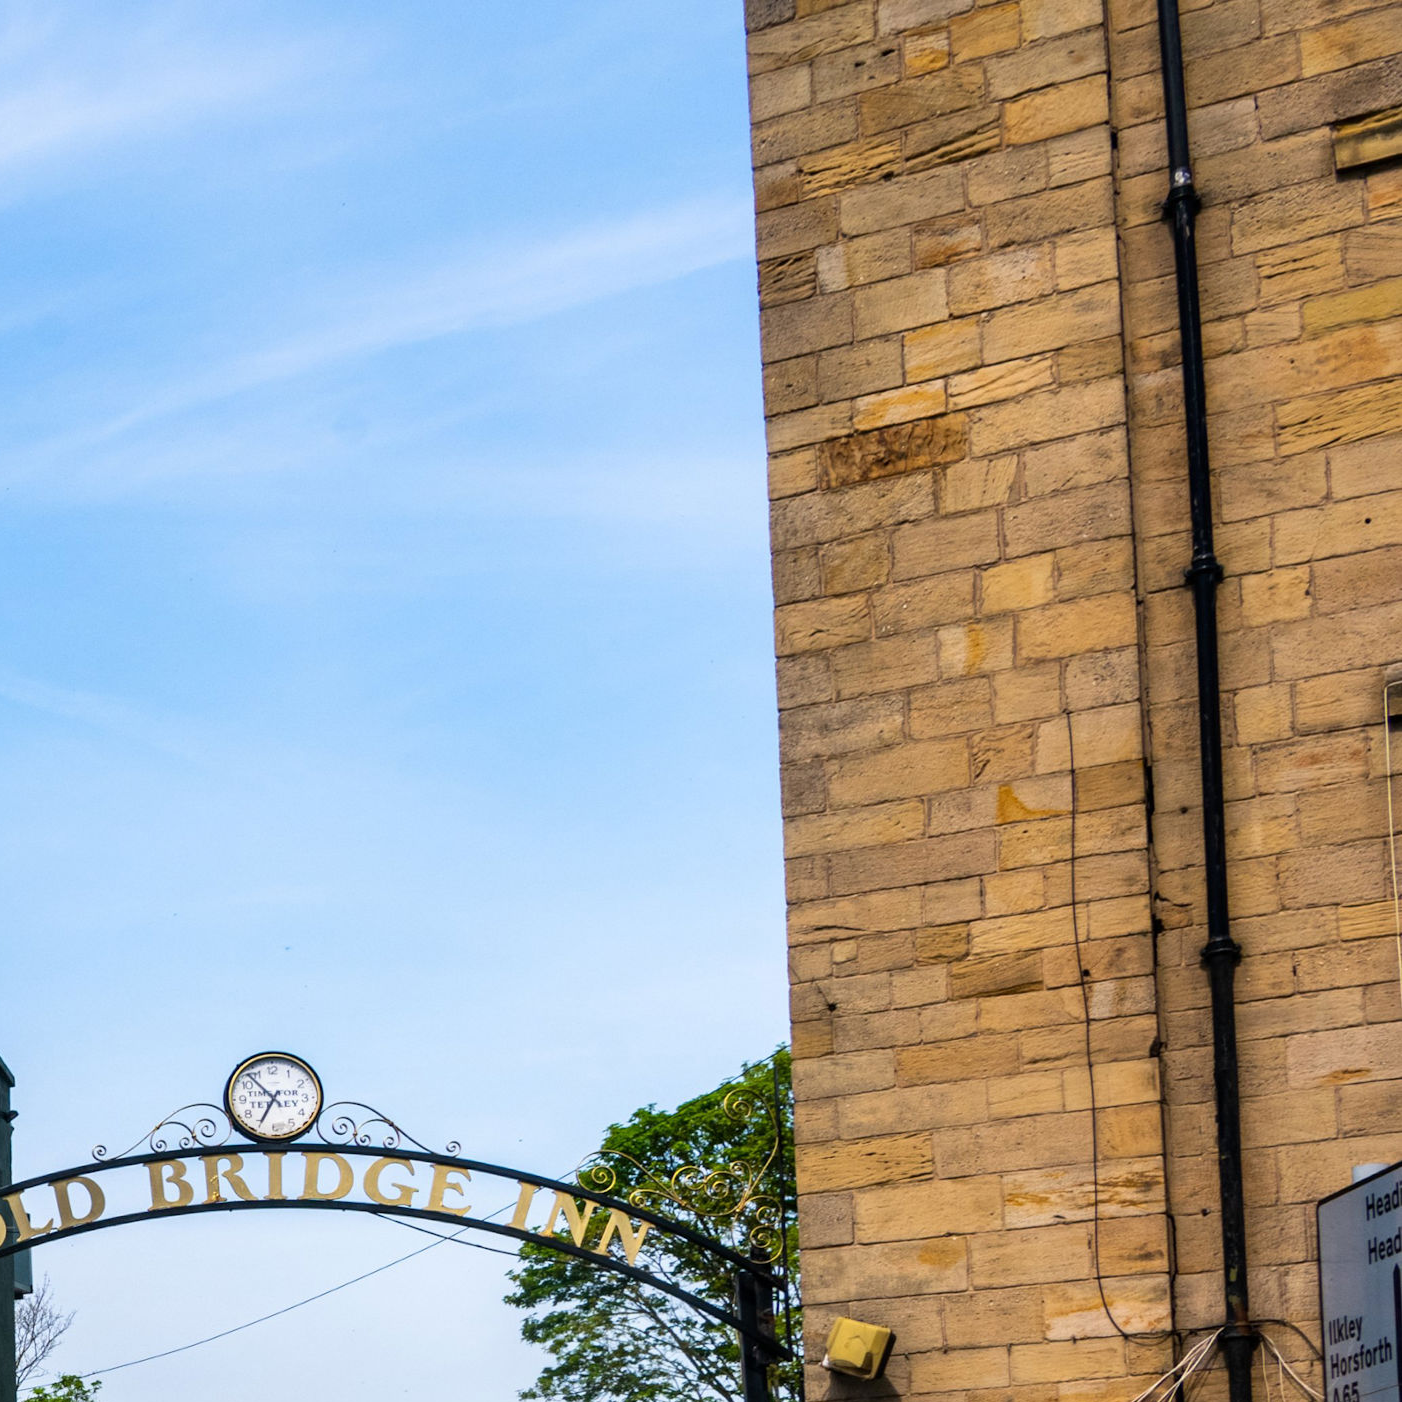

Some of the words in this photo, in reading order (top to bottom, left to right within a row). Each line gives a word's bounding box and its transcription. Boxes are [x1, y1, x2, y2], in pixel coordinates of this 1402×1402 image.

[267, 1066, 278, 1075] 12
[242, 1080, 254, 1090] 10
[297, 1080, 305, 1089] 2
[239, 1095, 247, 1105] 9
[301, 1094, 309, 1103] 3
[249, 1100, 299, 1109] TETEY
[244, 1109, 253, 1119] 8
[298, 1108, 306, 1117] 4
[288, 1118, 296, 1128] 5
[143, 1151, 472, 1217] BRIDGE
[506, 1180, 657, 1266] INN
[1329, 1315, 1363, 1346] Ilkley
[1330, 1336, 1393, 1380] Horsforth
